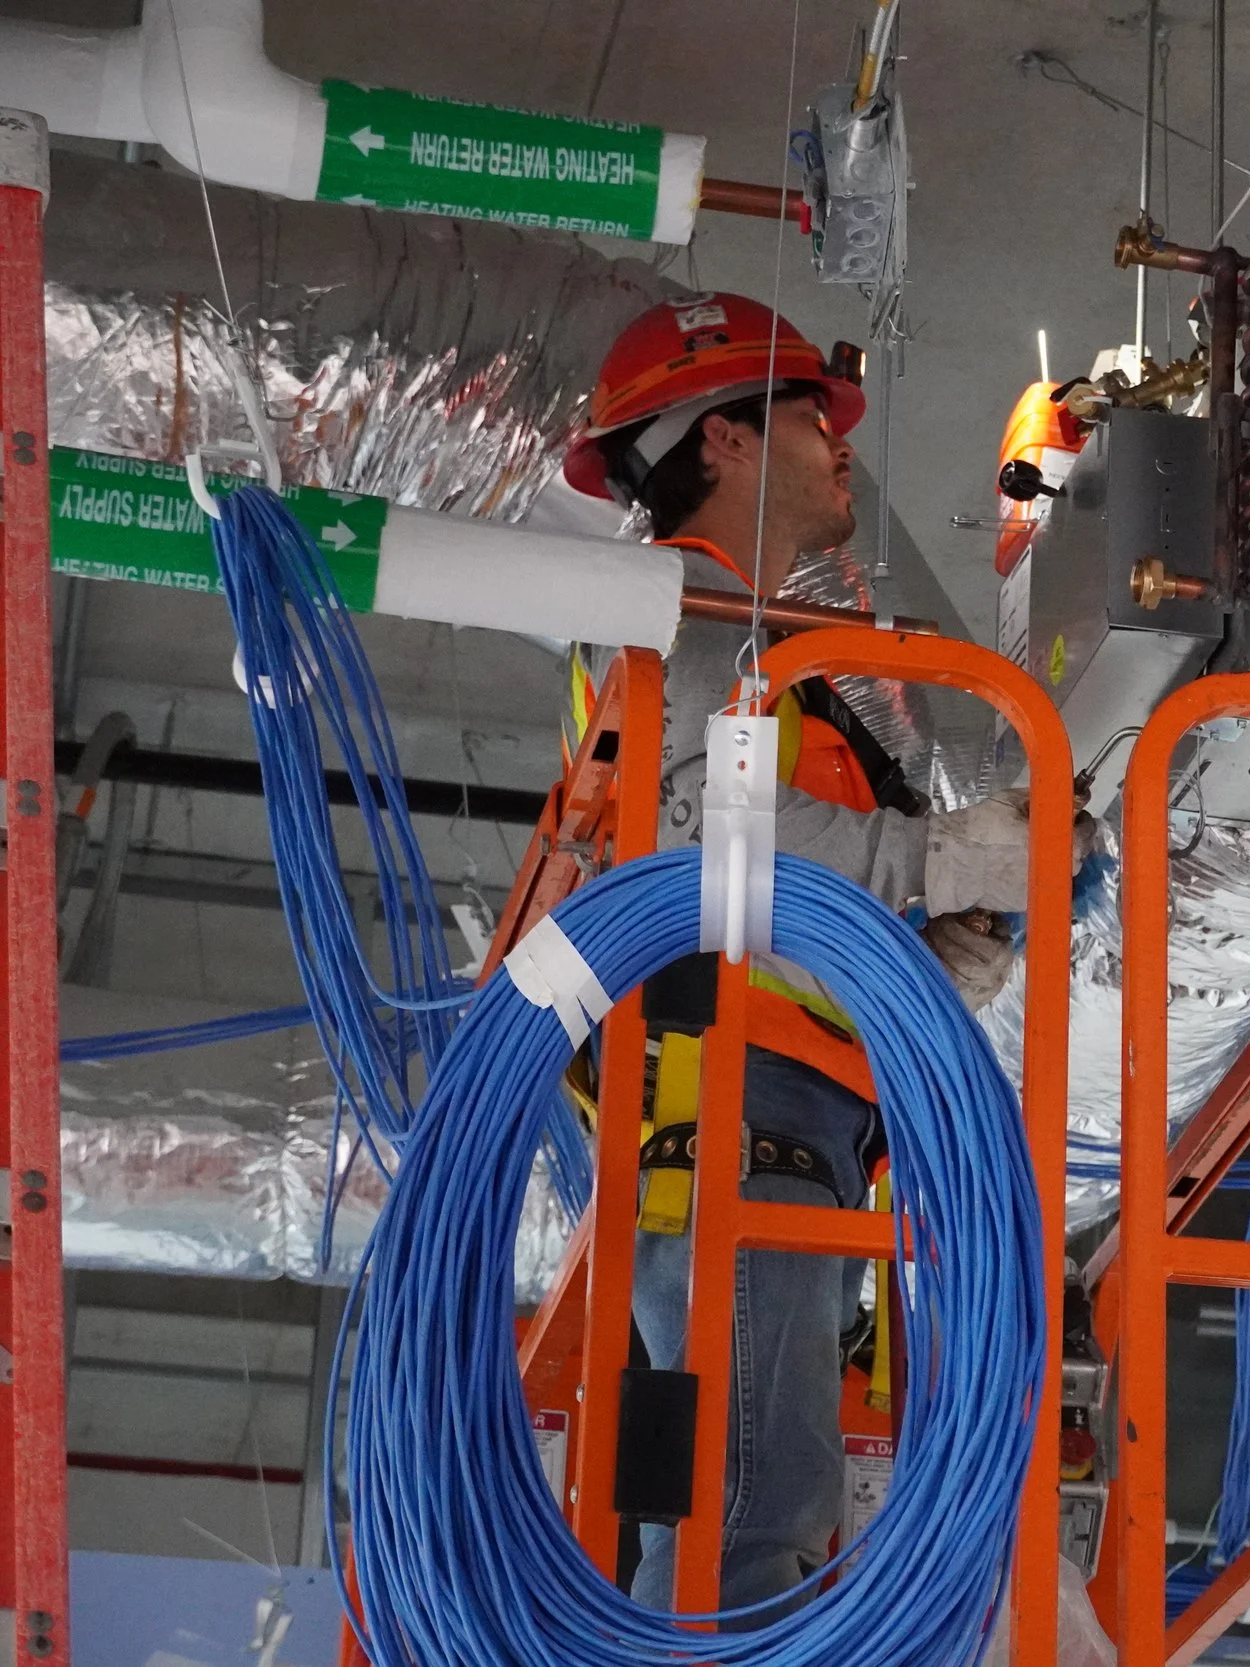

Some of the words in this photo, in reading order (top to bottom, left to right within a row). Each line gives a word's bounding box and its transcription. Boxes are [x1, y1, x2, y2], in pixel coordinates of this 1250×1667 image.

[410, 131, 485, 173] RETURN
[488, 141, 550, 180] WATER
[555, 147, 635, 186] HEATING
[403, 199, 483, 221] HEATING
[488, 209, 551, 229] WATER
[554, 215, 630, 237] RETURN
[59, 484, 134, 528] SUPPLY
[138, 493, 205, 535] WATER
[144, 568, 210, 593] WATER
